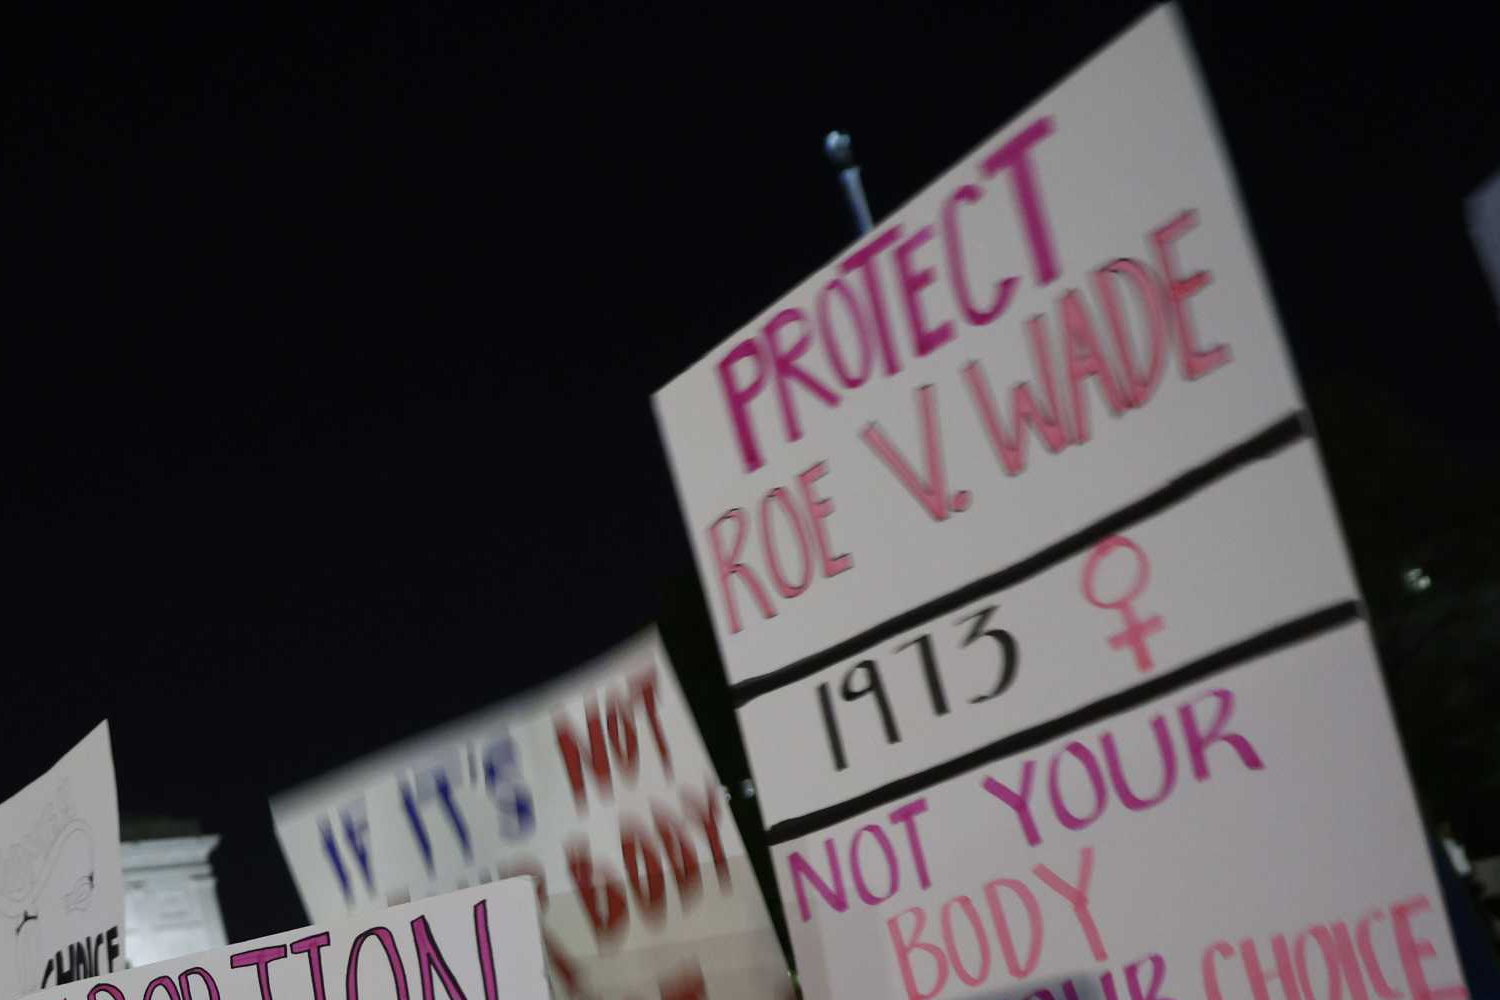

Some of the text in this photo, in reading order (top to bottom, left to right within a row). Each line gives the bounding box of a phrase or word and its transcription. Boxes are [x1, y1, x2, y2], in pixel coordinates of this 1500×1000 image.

[716, 114, 1057, 473] PROTECT
[705, 208, 1234, 635] ROE V. WADE
[554, 667, 676, 812] NOT
[815, 605, 1020, 772] 1973
[565, 785, 732, 945] BODY
[787, 687, 1265, 922] NOT YOUR
